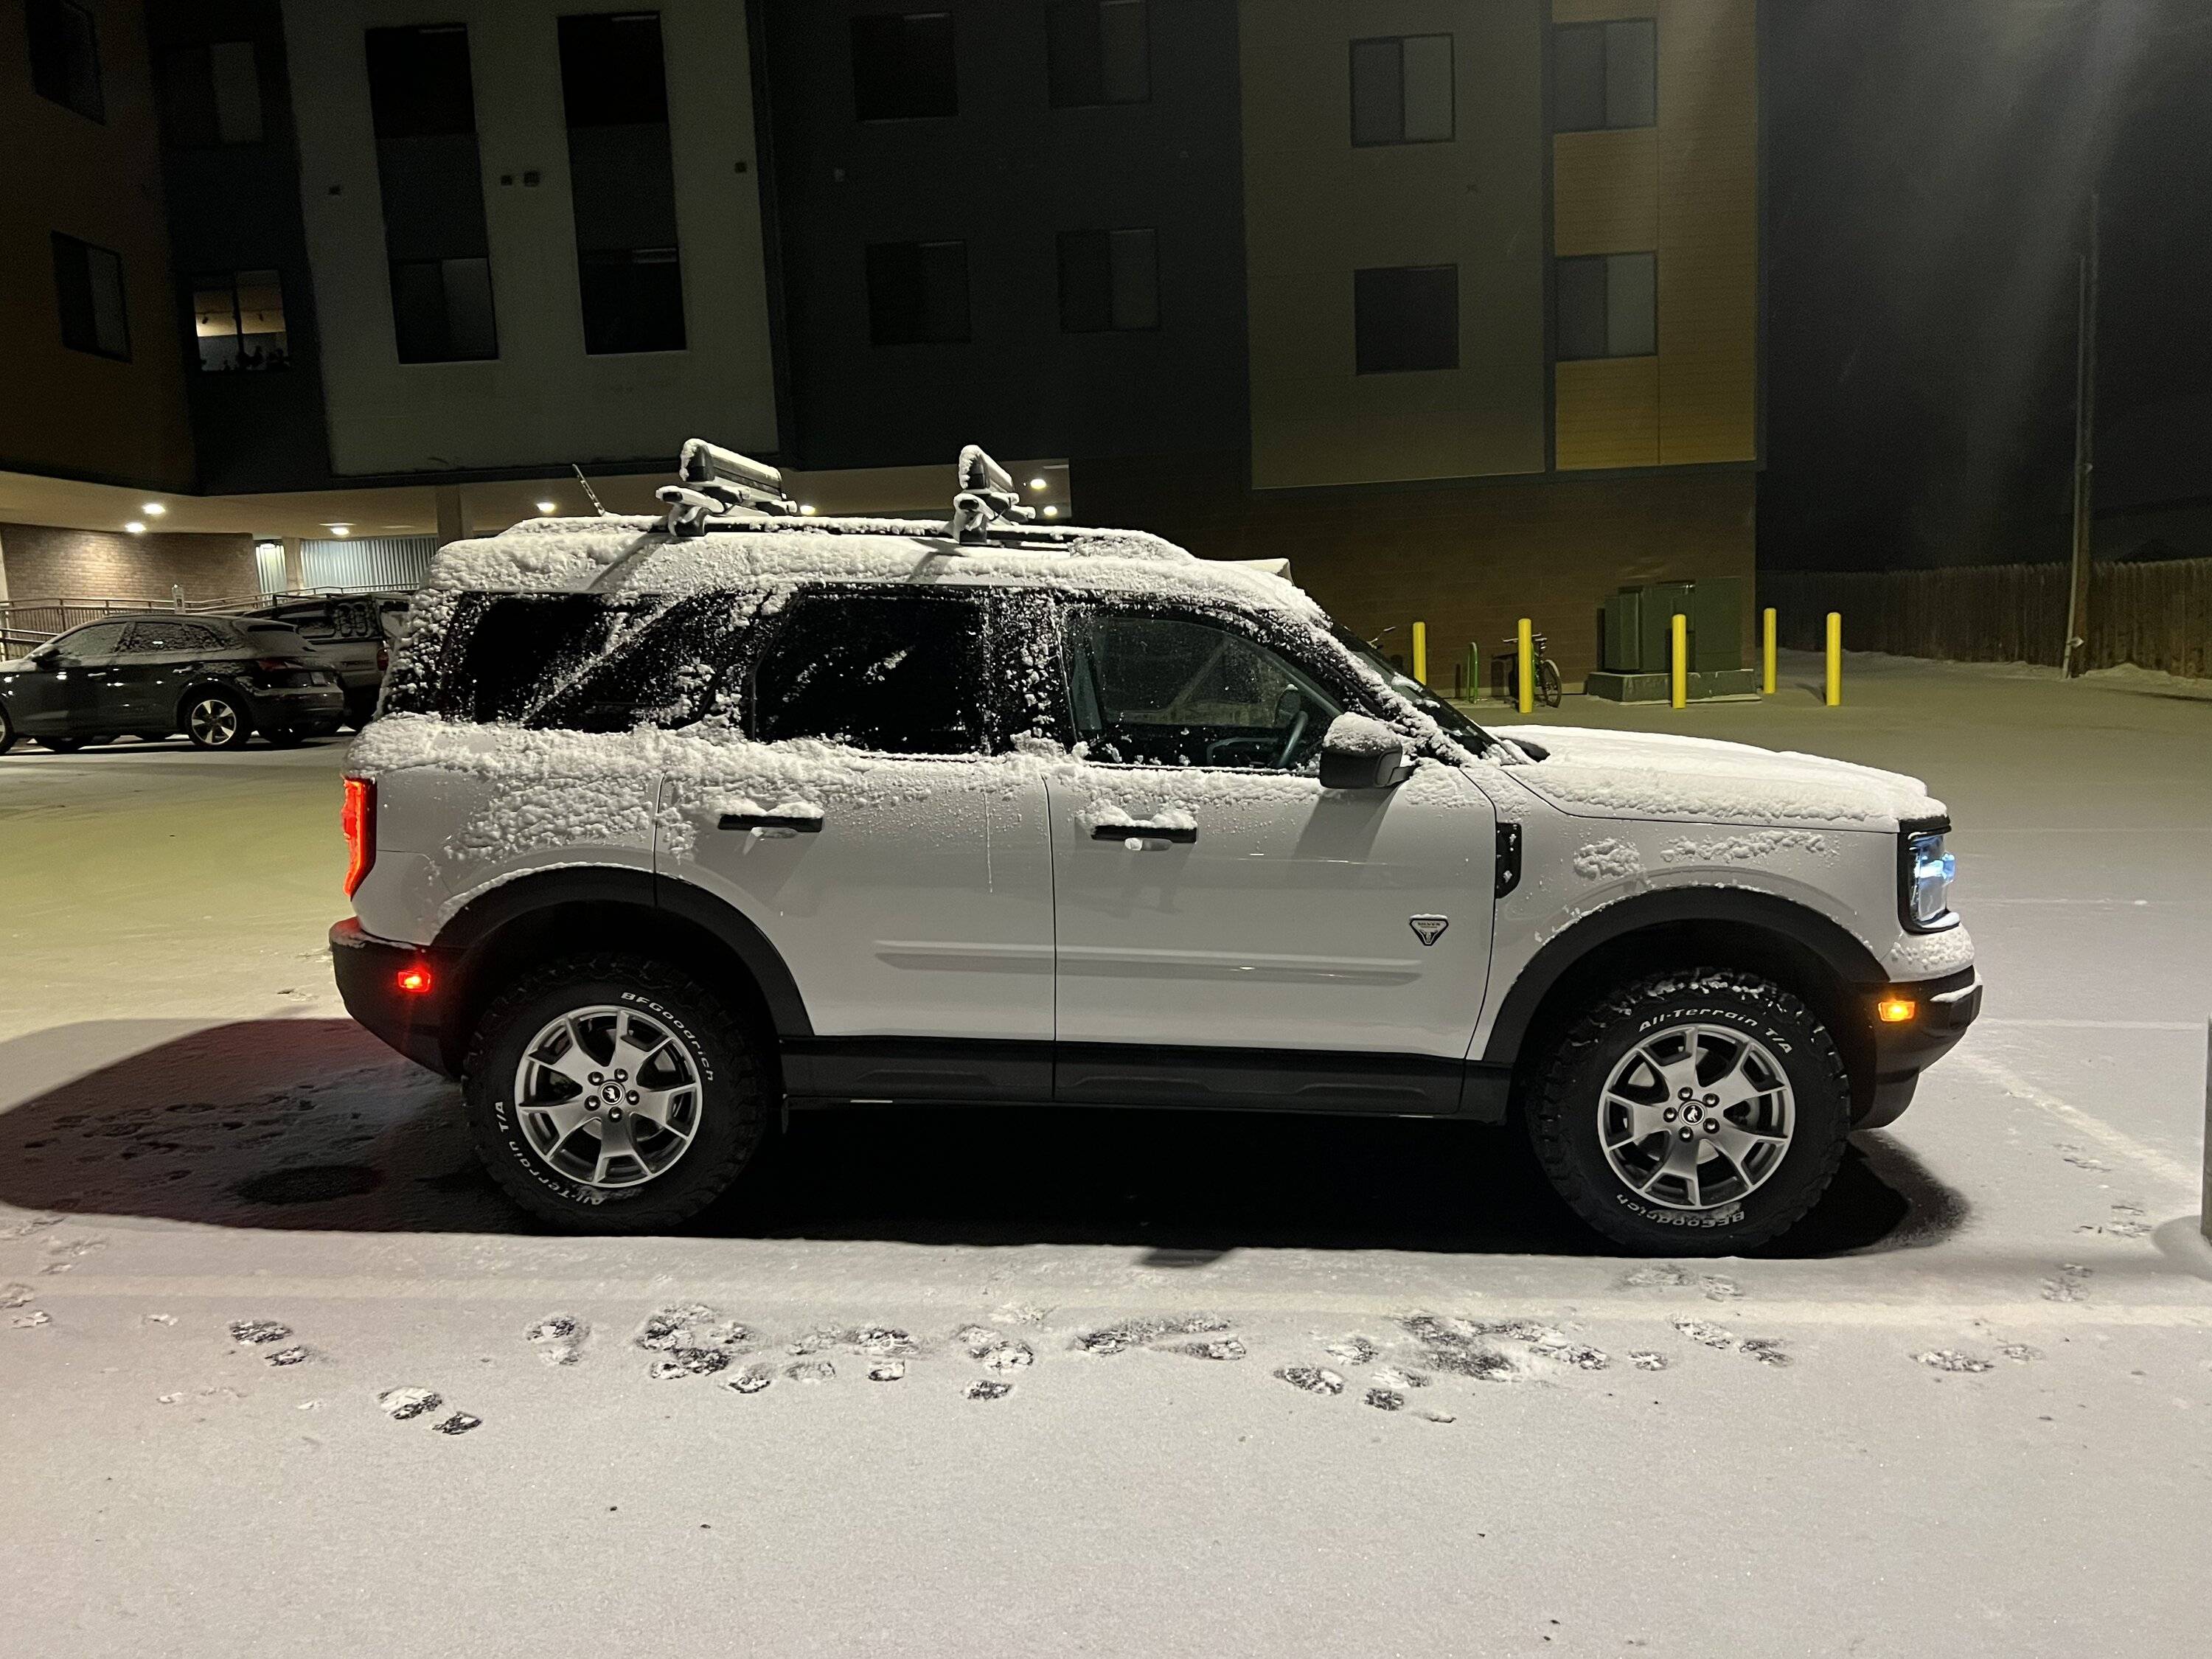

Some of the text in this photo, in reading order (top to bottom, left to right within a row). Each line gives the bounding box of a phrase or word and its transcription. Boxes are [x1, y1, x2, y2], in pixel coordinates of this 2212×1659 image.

[621, 992, 714, 1082] BFGoodrich
[1639, 1007, 1793, 1054] All-Terrain T/A
[495, 1101, 605, 1206] All-Terrain T/A
